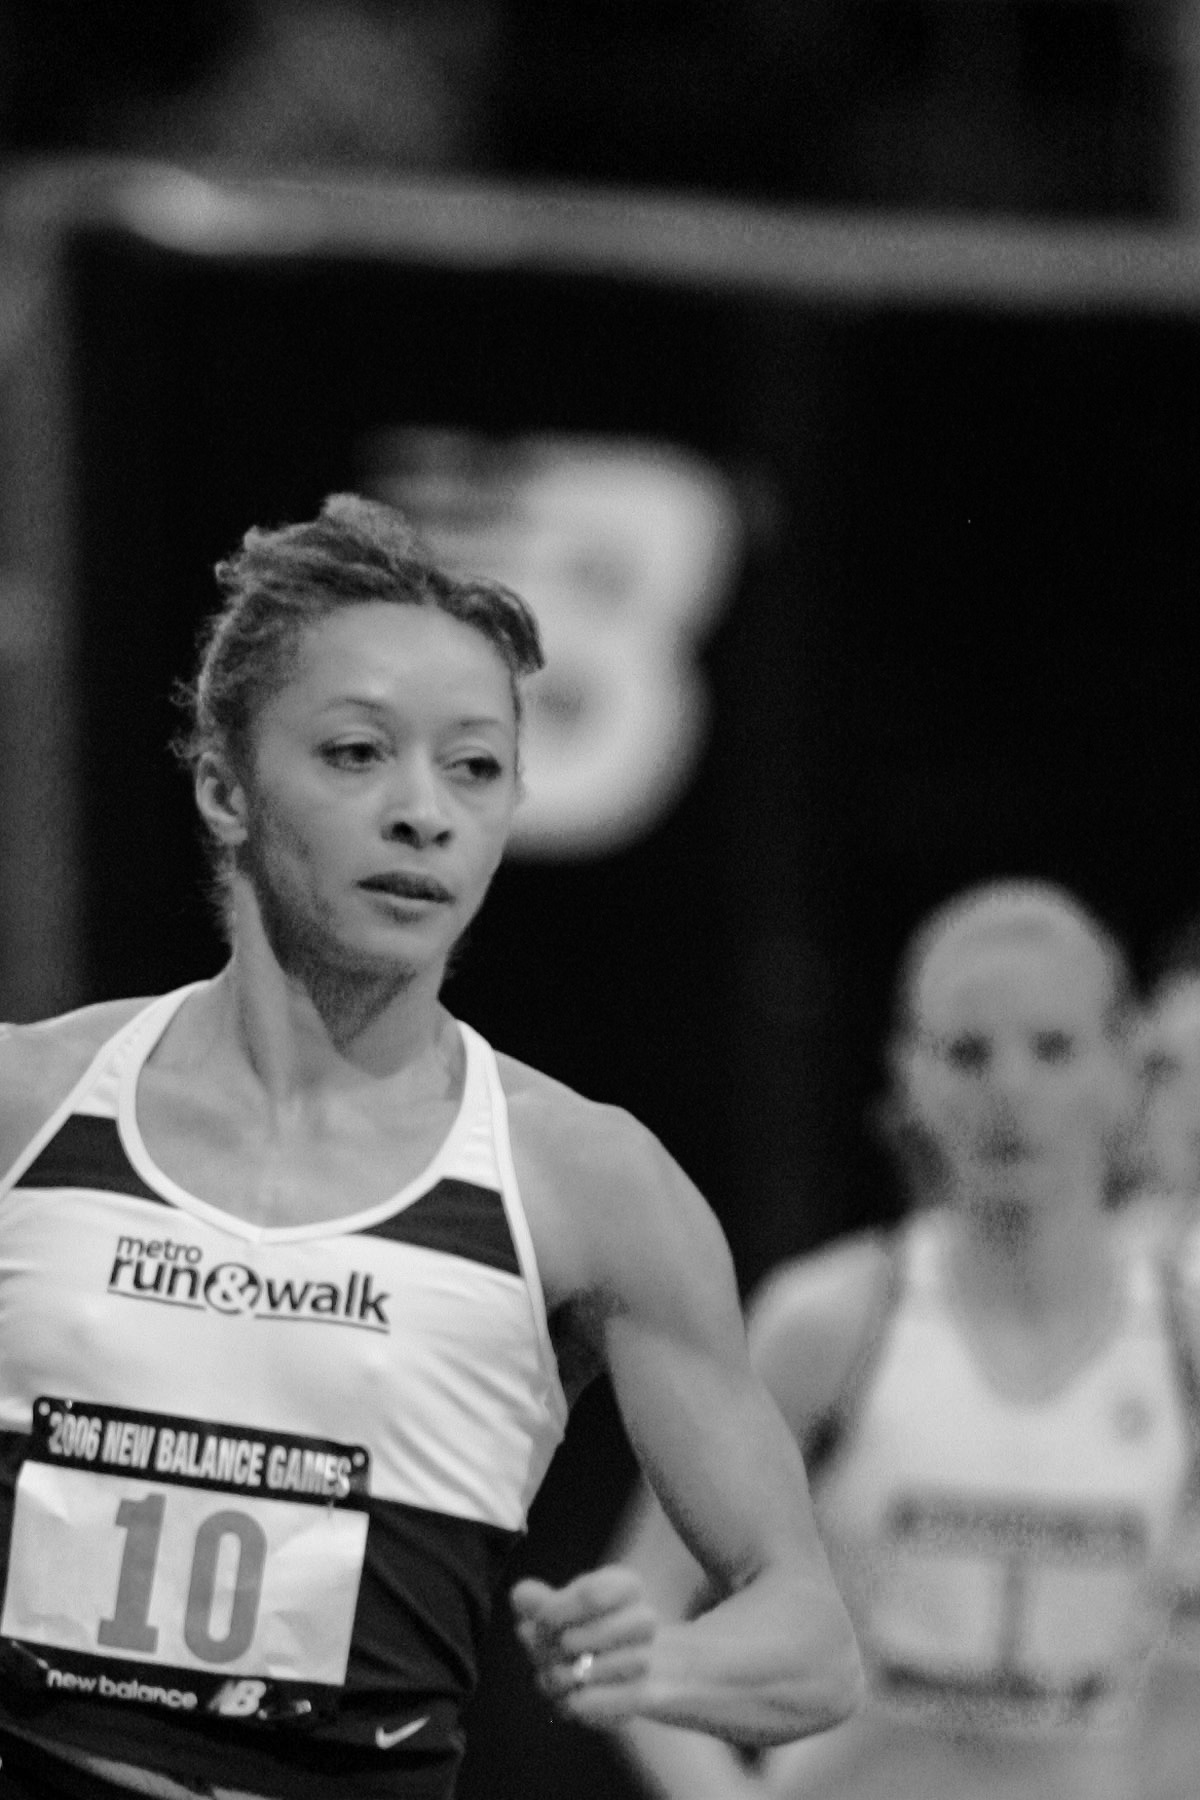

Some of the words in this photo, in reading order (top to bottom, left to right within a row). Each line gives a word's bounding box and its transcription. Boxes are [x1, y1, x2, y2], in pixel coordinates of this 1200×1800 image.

[116, 1235, 203, 1264] metro
[48, 1411, 102, 1461] 2006
[102, 1420, 156, 1469] NEW
[155, 1427, 266, 1487] BALANCE
[266, 1444, 352, 1498] GAMES
[97, 1493, 267, 1664] 10
[46, 1669, 98, 1692] new
[98, 1675, 198, 1710] balance
